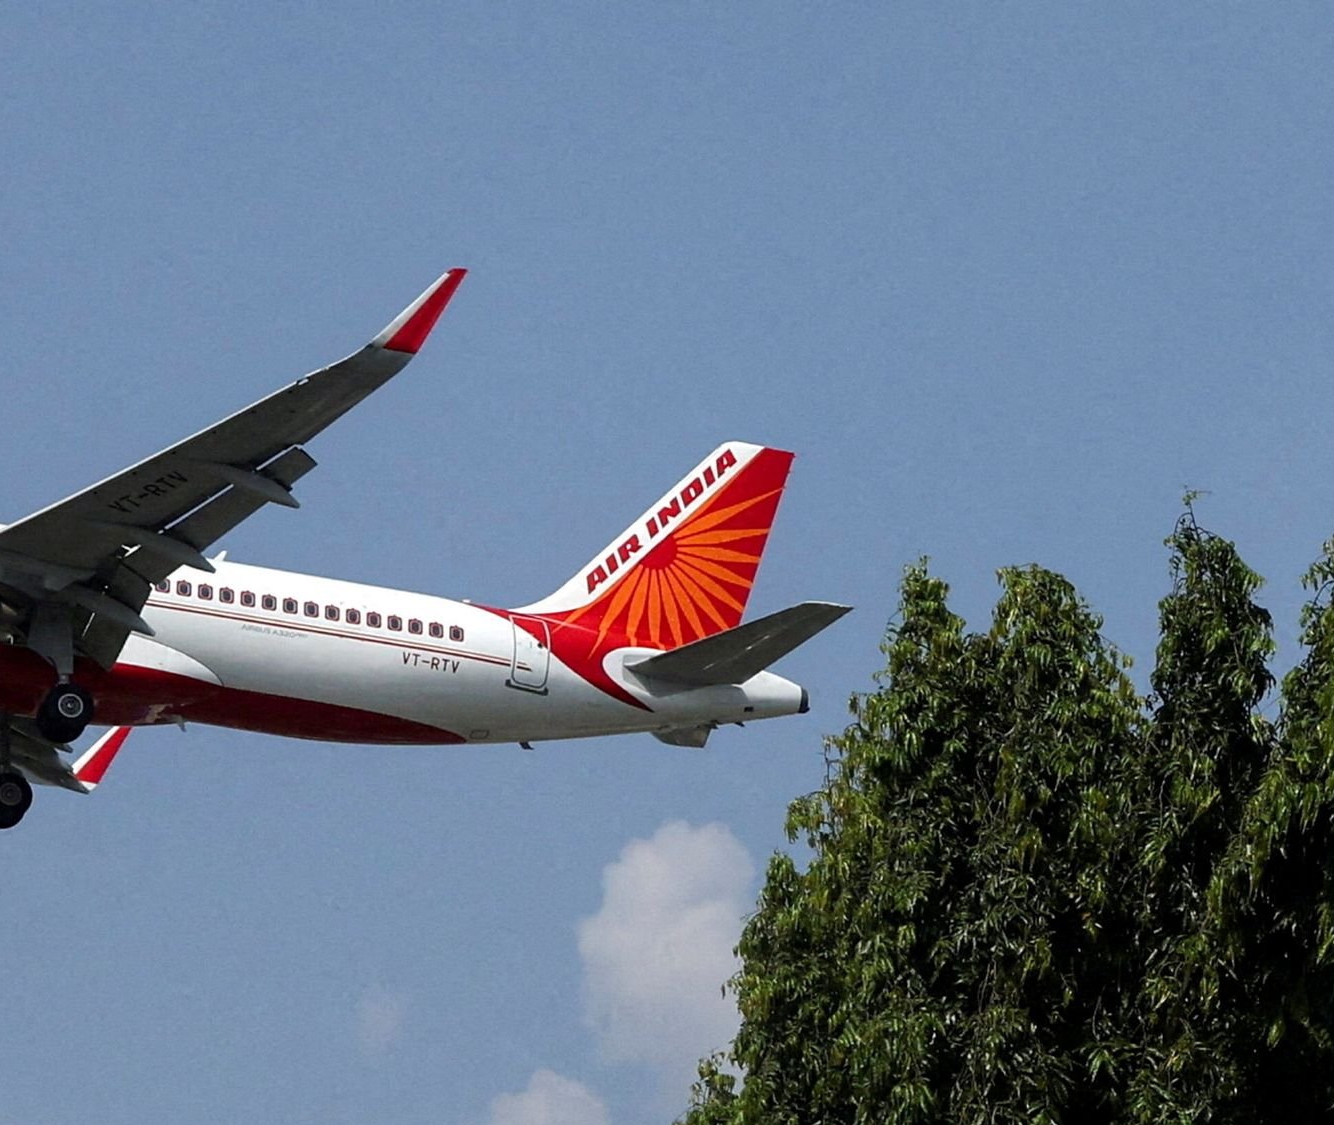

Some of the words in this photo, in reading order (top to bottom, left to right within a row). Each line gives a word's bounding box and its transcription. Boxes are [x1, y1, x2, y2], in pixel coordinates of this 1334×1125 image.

[107, 470, 188, 513] VT-RTV
[586, 534, 643, 595] AIR
[646, 448, 737, 540] INDIA
[402, 652, 460, 674] VT-RTV
